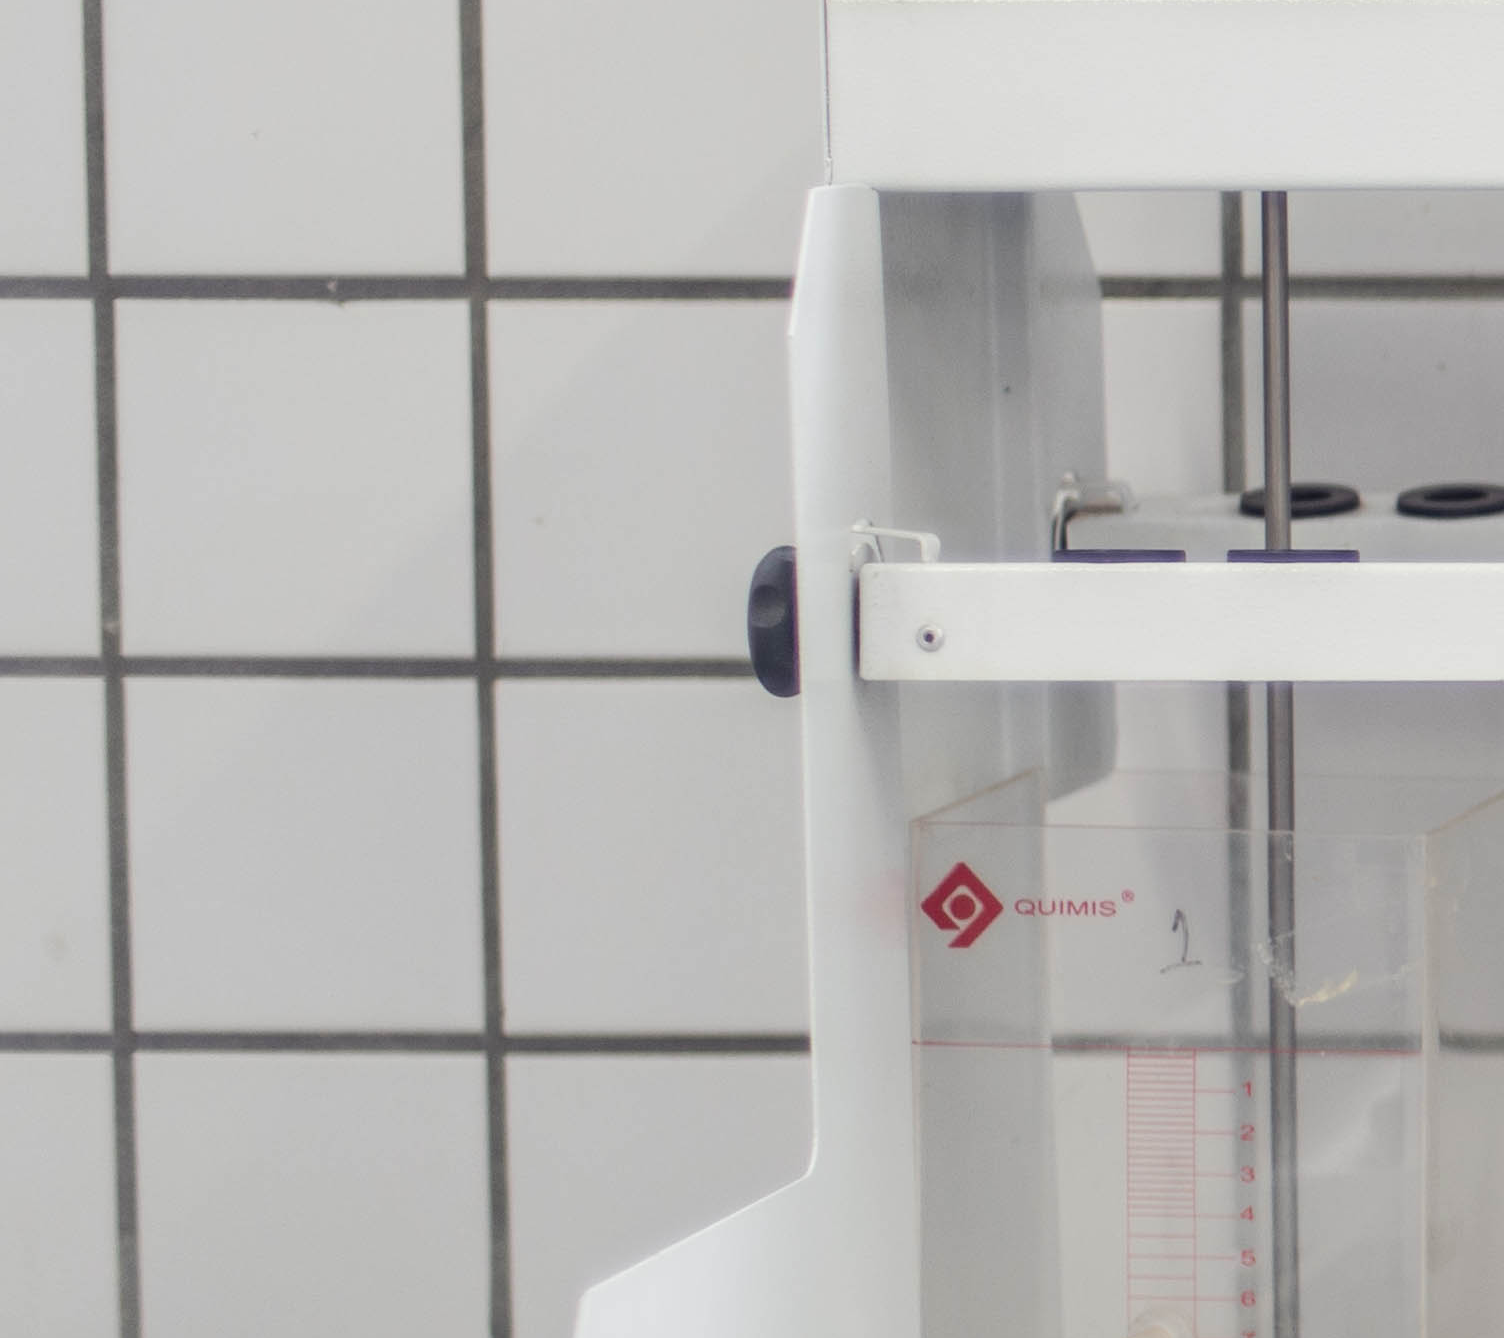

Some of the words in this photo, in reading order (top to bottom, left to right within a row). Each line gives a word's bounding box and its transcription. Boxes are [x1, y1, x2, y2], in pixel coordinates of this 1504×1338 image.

[1242, 1080, 1254, 1098] 1
[1240, 1124, 1256, 1142] 2
[1240, 1166, 1256, 1184] 3
[1240, 1205, 1255, 1222] 4
[1241, 1248, 1257, 1267] 5
[1241, 1289, 1257, 1307] 6
